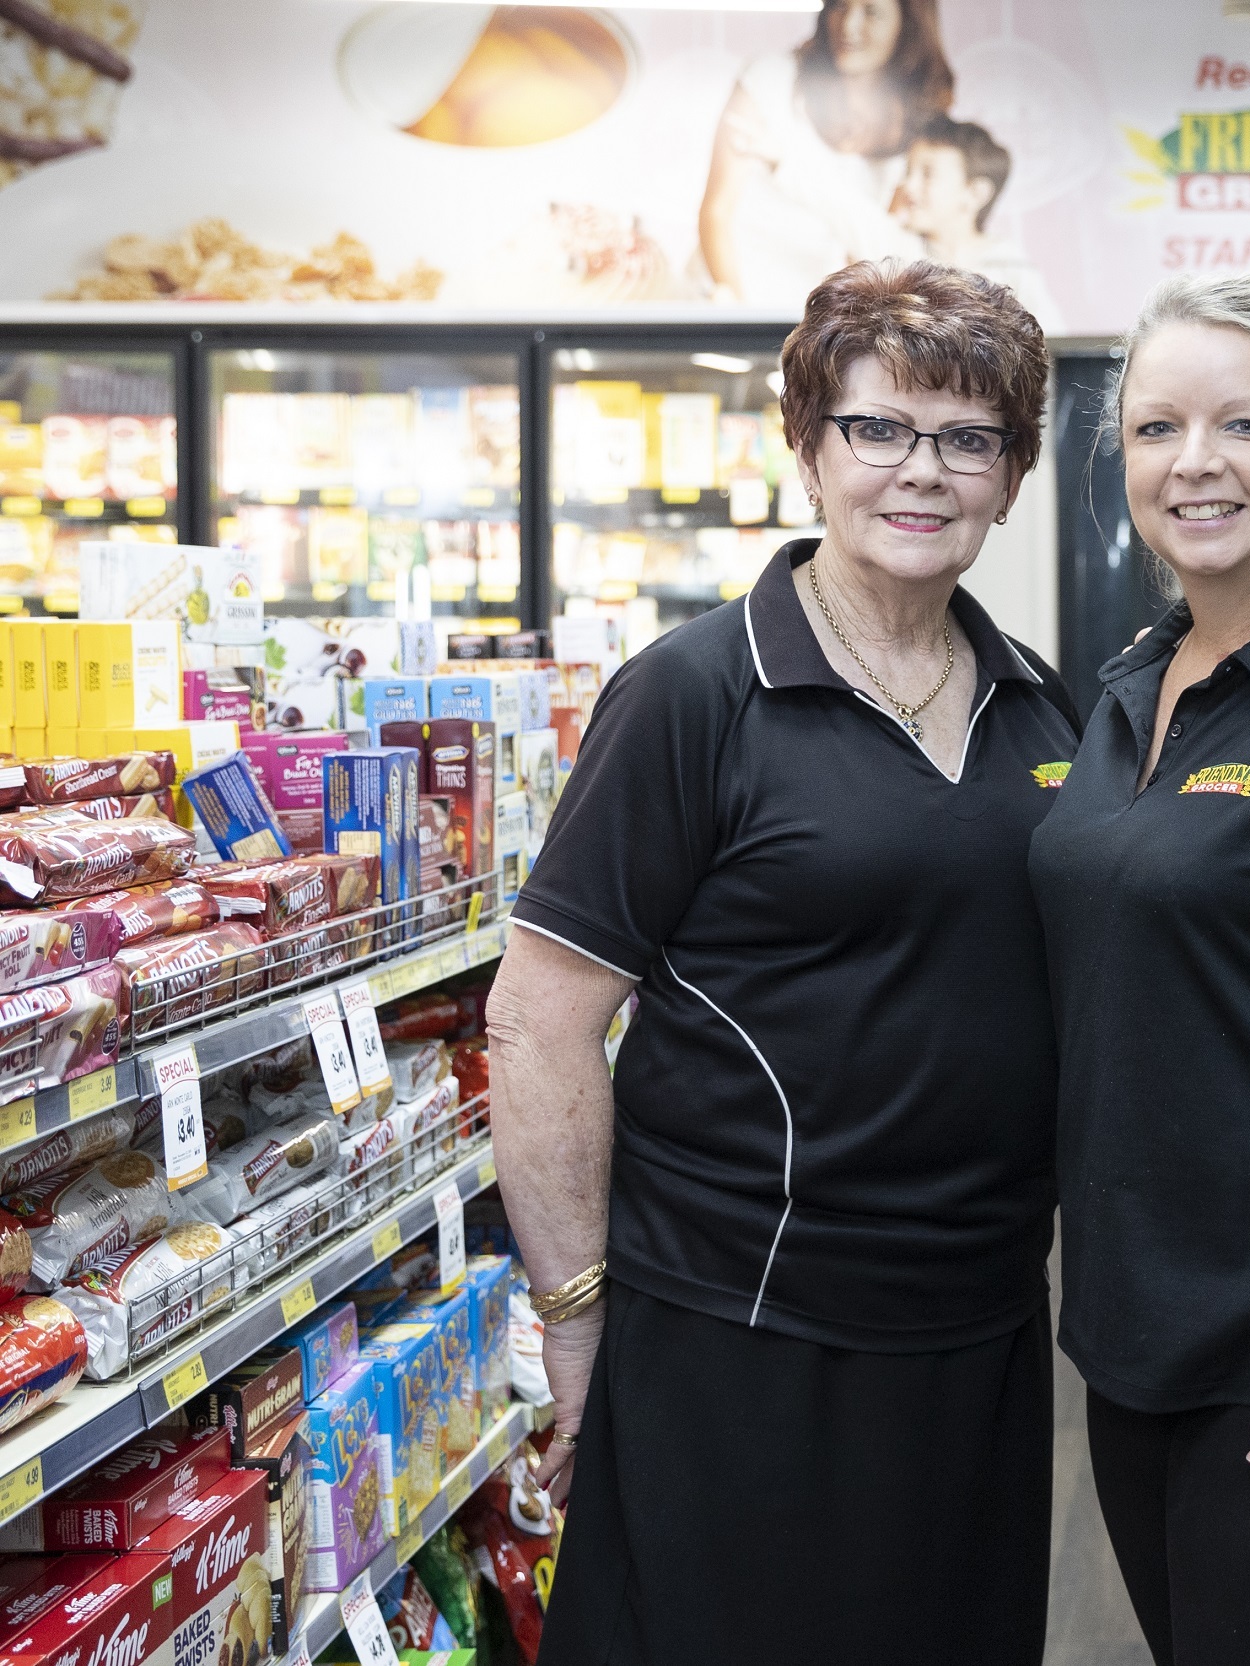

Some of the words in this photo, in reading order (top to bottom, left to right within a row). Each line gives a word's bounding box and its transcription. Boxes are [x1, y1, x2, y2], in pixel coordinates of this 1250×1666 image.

[54, 759, 90, 782] ARNOTT'S
[436, 772, 467, 789] THINS
[1191, 782, 1239, 793] GROCER
[84, 843, 133, 876] ARNOTT'S
[287, 876, 324, 915] ARNOTT'S
[4, 964, 22, 980] ROLL
[307, 1002, 336, 1024] SPECIAL
[343, 988, 370, 1009] SPECIAL
[159, 1056, 194, 1084] SPECIAL
[18, 1134, 71, 1186] ARNOTT'S
[81, 1222, 128, 1270] ARNOTT'S
[247, 1374, 301, 1433] NUTRI-GRAIN
[26, 1466, 39, 1485] 4.99
[174, 1463, 195, 1489] K-Time
[83, 1507, 92, 1545] TWISTS
[92, 1509, 102, 1543] BAKED
[104, 1508, 118, 1547] K-Time
[195, 1514, 250, 1595] K-Time
[154, 1576, 172, 1603] NEW
[174, 1609, 211, 1657] BAKED
